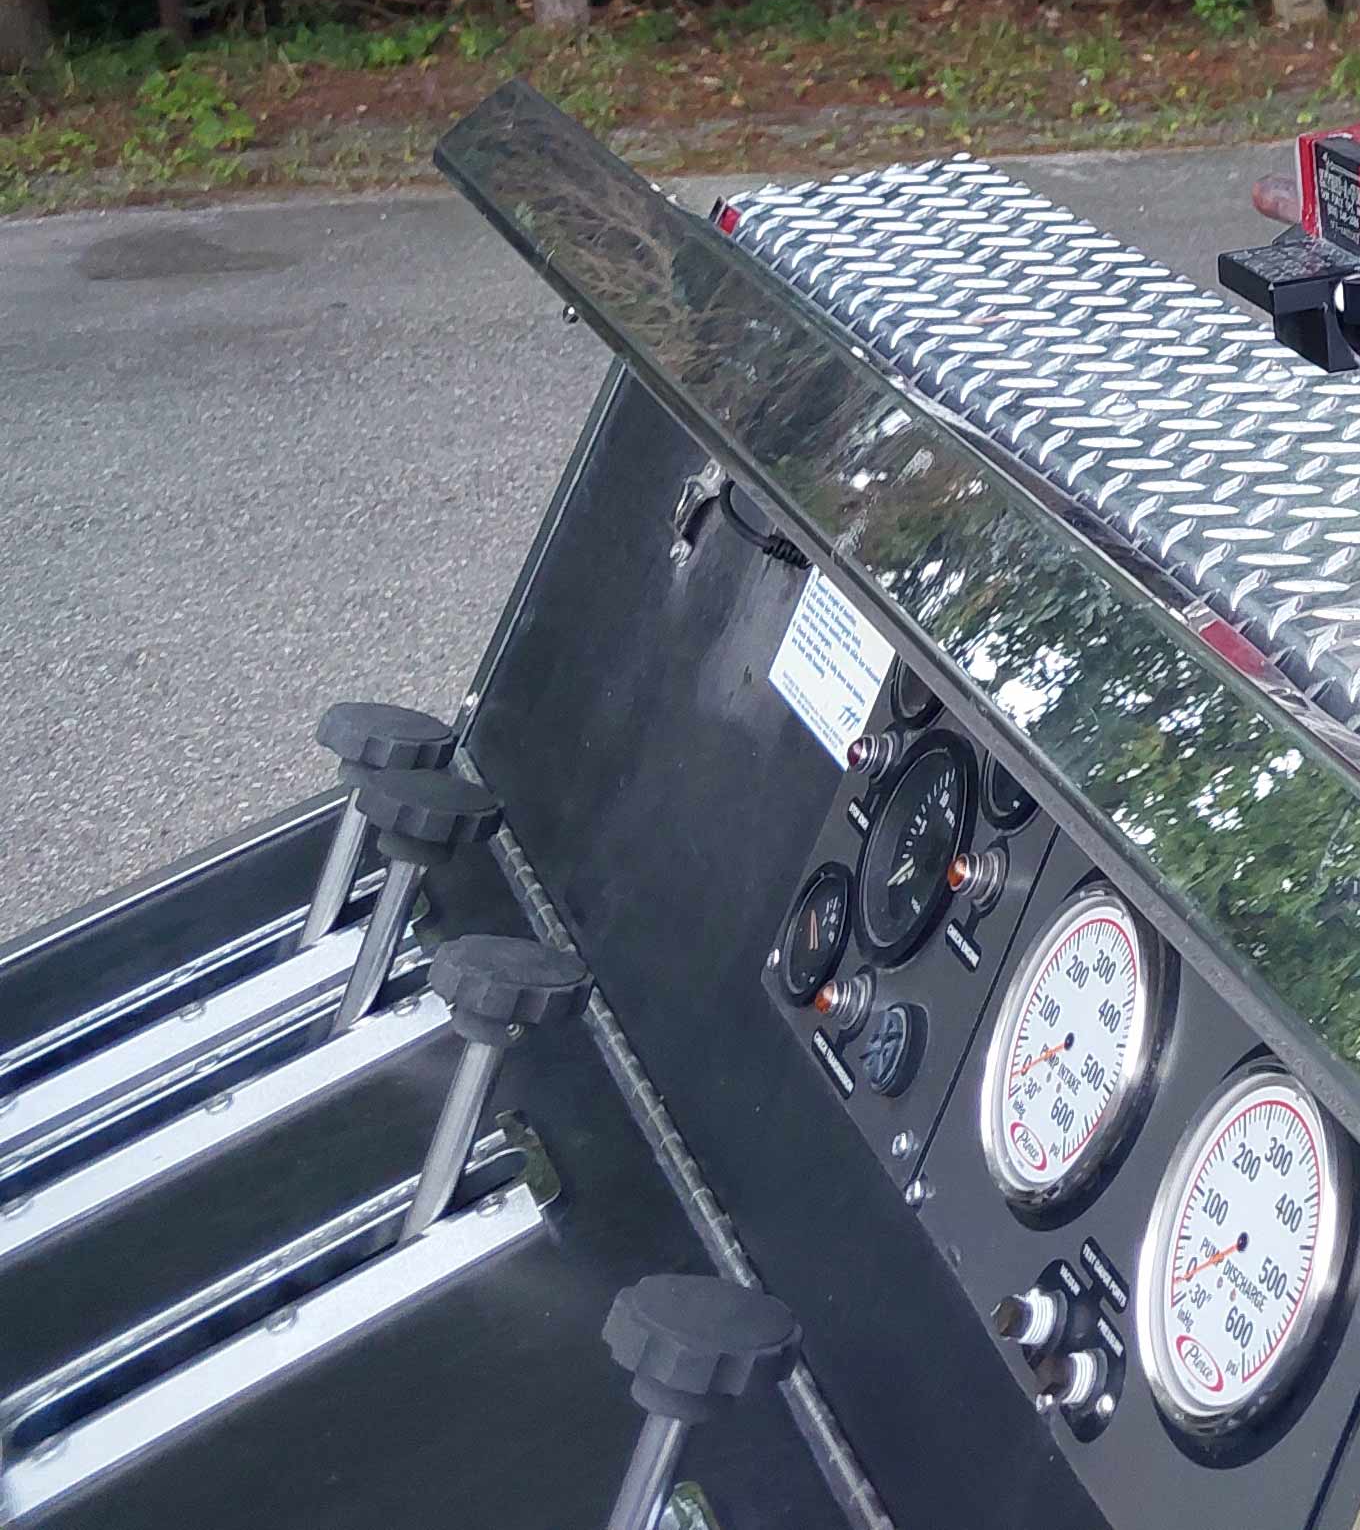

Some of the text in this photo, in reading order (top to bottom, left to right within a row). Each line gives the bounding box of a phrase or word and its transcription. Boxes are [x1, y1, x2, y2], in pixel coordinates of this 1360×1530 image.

[1065, 955, 1090, 989] 200
[1093, 950, 1116, 984] 300
[1039, 994, 1061, 1027] 100
[1098, 998, 1121, 1033] 400
[1021, 1054, 1032, 1076] 0
[1040, 1043, 1081, 1096] PMP INTAKE
[1080, 1054, 1105, 1091] 500
[1050, 1096, 1074, 1133] 600
[1016, 1129, 1040, 1162] Pierce
[1232, 1142, 1261, 1182] 200
[1265, 1137, 1293, 1177] 300
[1202, 1188, 1229, 1226] 100
[1275, 1193, 1303, 1233] 400
[1185, 1257, 1198, 1282] 0
[1222, 1259, 1268, 1314] DISCHARGE
[1258, 1257, 1288, 1300] 500
[1225, 1306, 1254, 1348] 600
[1185, 1343, 1213, 1381] Pierce
[1225, 1359, 1241, 1377] psi
